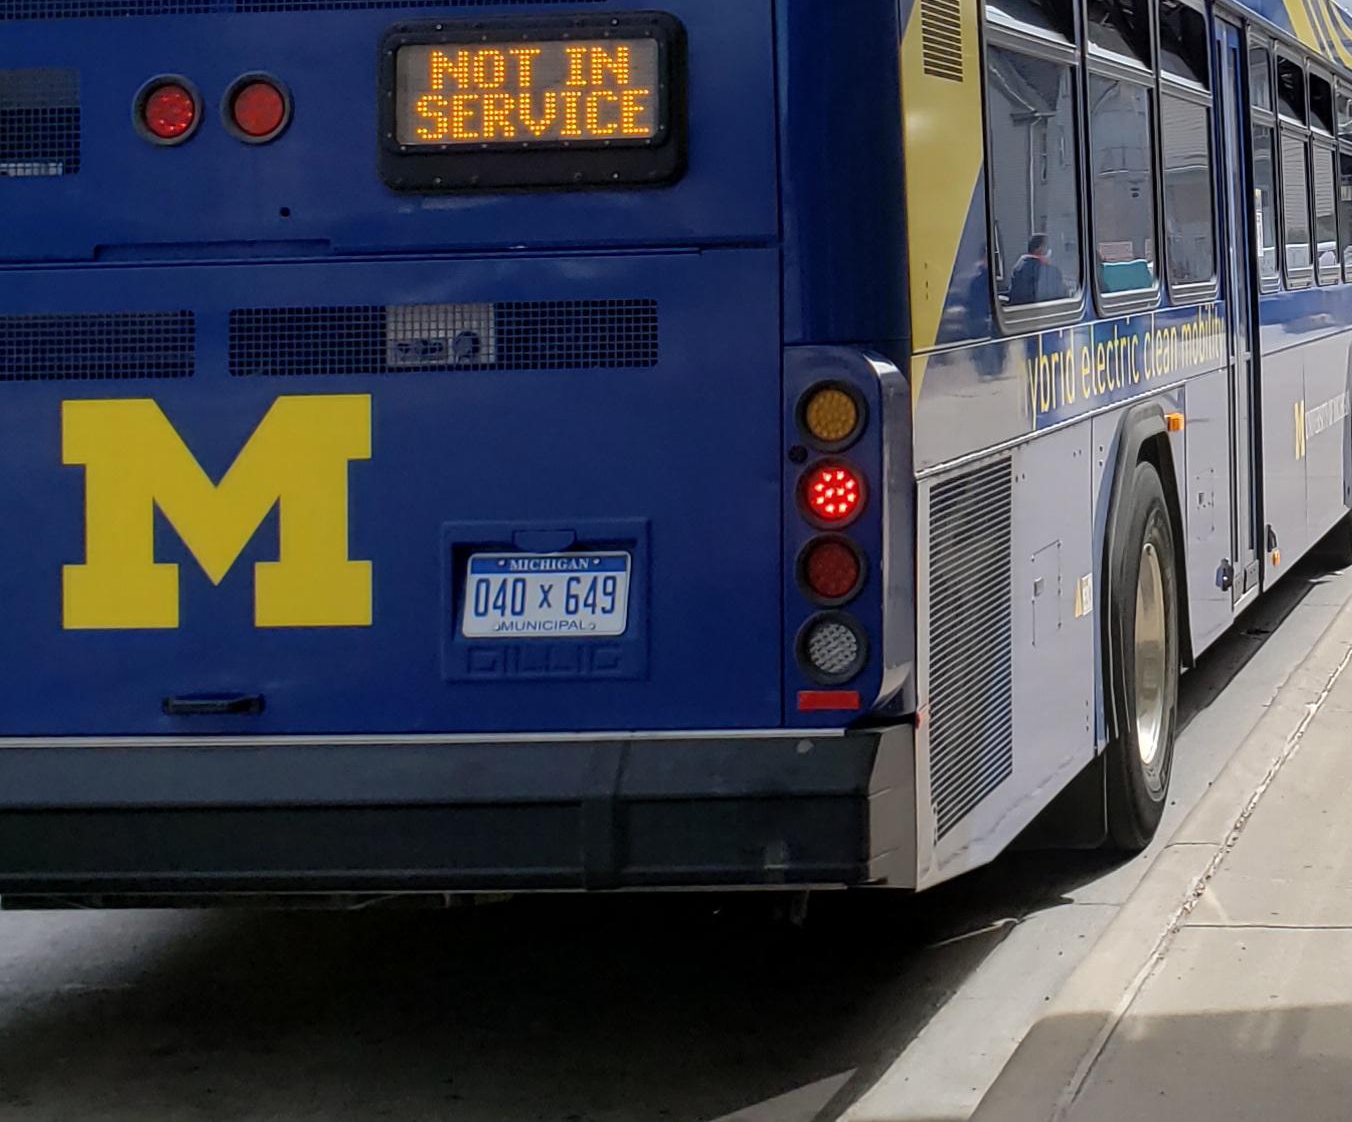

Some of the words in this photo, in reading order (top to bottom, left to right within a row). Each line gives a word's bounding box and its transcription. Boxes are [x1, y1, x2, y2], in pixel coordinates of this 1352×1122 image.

[430, 49, 541, 90] NOT
[564, 46, 630, 86] IN
[416, 89, 650, 140] SERVICE
[1081, 316, 1140, 399] electric
[1143, 312, 1178, 381] clean
[1181, 304, 1225, 367] mobility
[61, 393, 373, 630] M
[509, 558, 590, 572] MICHIGAN
[473, 577, 527, 618] 040
[564, 575, 617, 616] 649
[500, 620, 586, 632] MUNICIPAL
